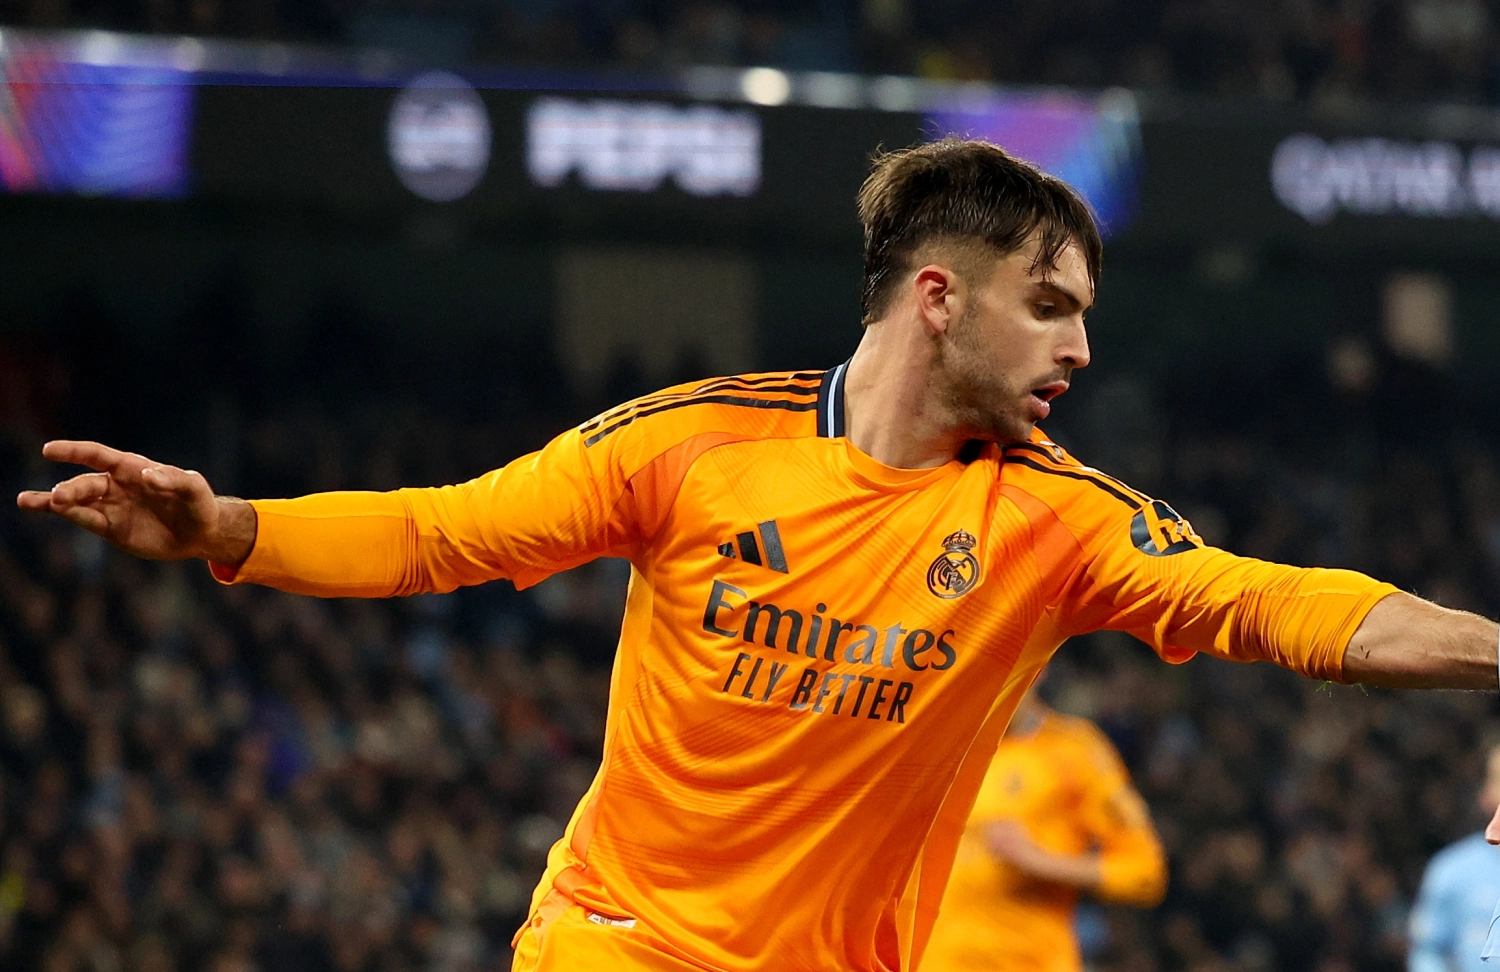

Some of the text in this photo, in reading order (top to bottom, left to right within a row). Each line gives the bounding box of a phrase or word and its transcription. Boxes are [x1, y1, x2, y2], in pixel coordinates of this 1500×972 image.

[1271, 134, 1462, 225] QATAR
[703, 579, 957, 672] Emirates
[723, 652, 914, 724] FLY BETTER
